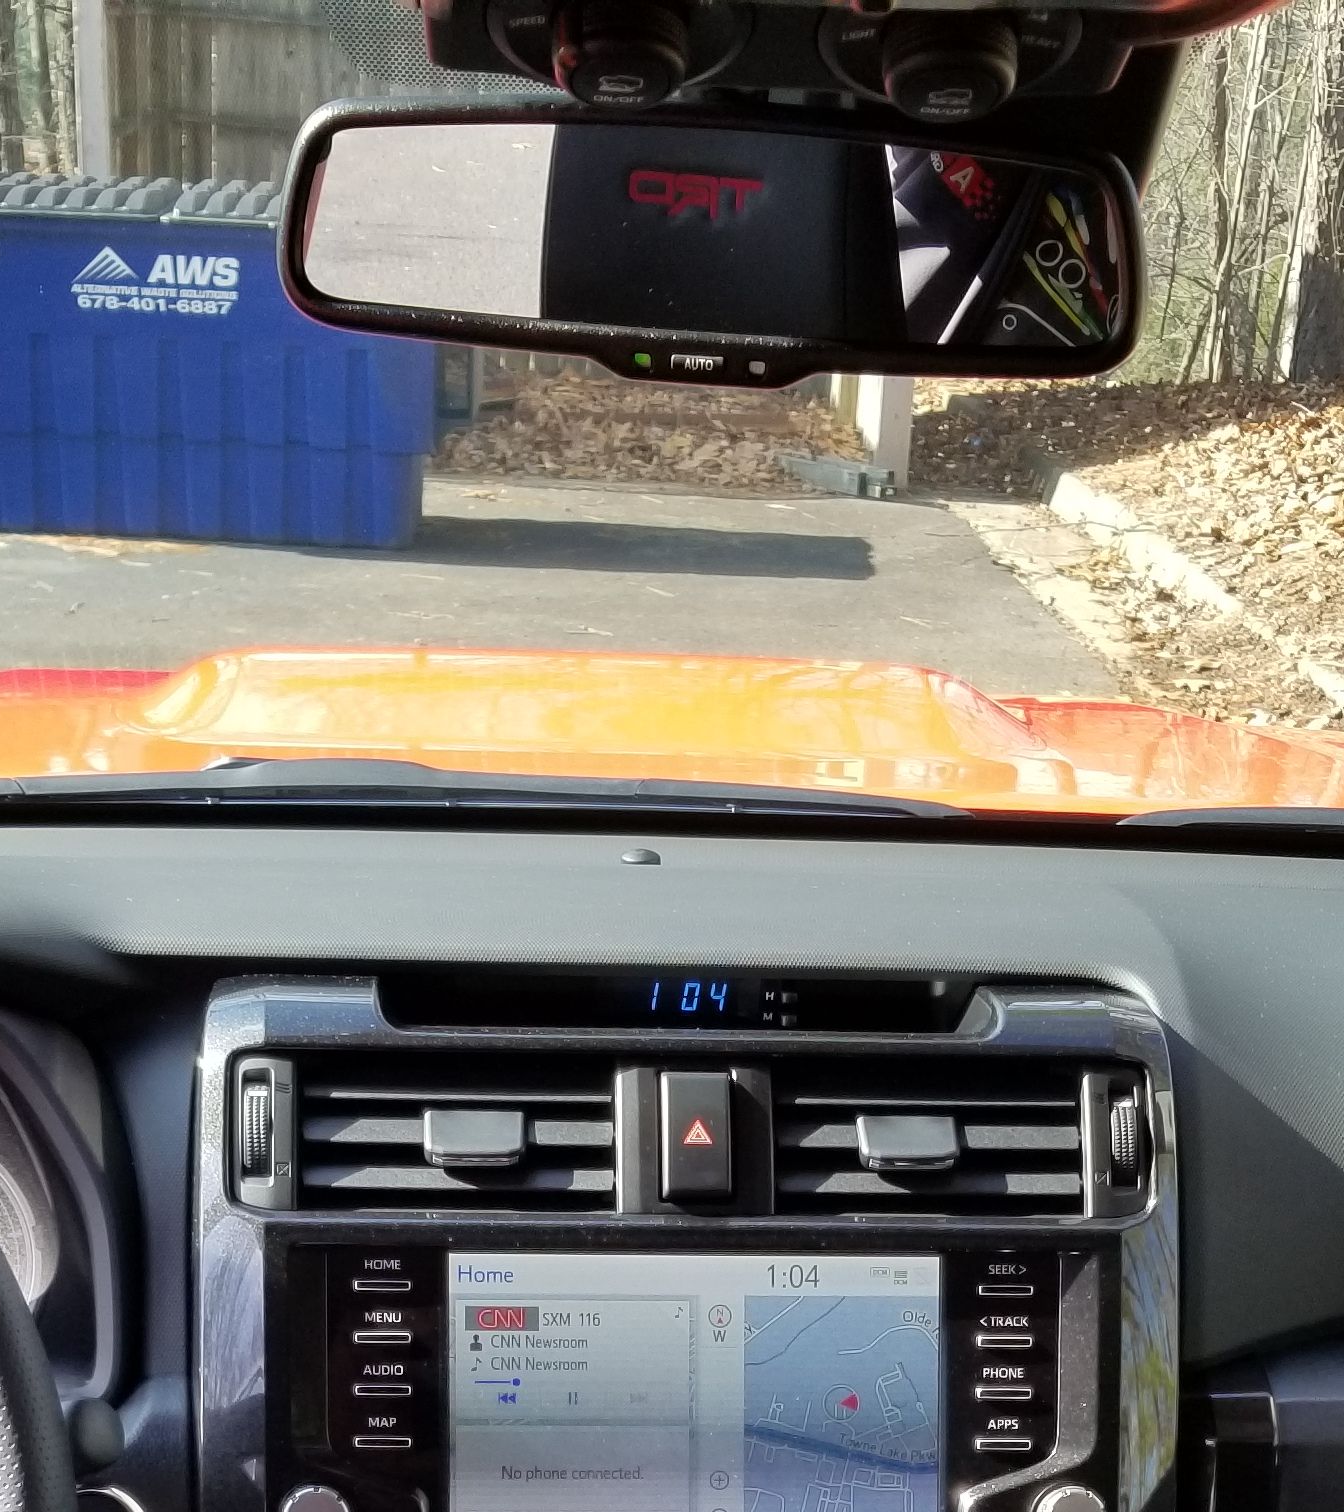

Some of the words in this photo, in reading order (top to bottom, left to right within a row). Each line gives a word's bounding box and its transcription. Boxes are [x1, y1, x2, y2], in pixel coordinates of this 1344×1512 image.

[593, 94, 644, 104] ON/OFF
[146, 254, 241, 286] AWS
[684, 357, 714, 371] AUTO
[364, 1259, 401, 1270] HOME
[988, 1264, 1016, 1275] SEEK
[458, 1265, 514, 1283] Home
[767, 1264, 820, 1289] 1:04
[364, 1312, 402, 1323] MENU
[716, 1308, 724, 1316] N
[477, 1309, 525, 1329] CNN
[542, 1312, 571, 1327] SXM
[579, 1312, 601, 1327] 116
[902, 1311, 932, 1327] Olde
[990, 1316, 1029, 1327] TRACK
[490, 1334, 521, 1349] CNN
[525, 1334, 588, 1349] Newsroom
[712, 1330, 727, 1342] W
[363, 1364, 404, 1376] AUDIO
[490, 1356, 521, 1371] CNN
[525, 1356, 588, 1371] Newsroom
[983, 1368, 1025, 1379] PHONE
[368, 1417, 397, 1428] MAP
[987, 1419, 1019, 1430] APPS
[839, 1433, 877, 1452] Towne
[501, 1466, 522, 1480] No
[526, 1466, 567, 1482] phone
[571, 1466, 644, 1480] connected.
